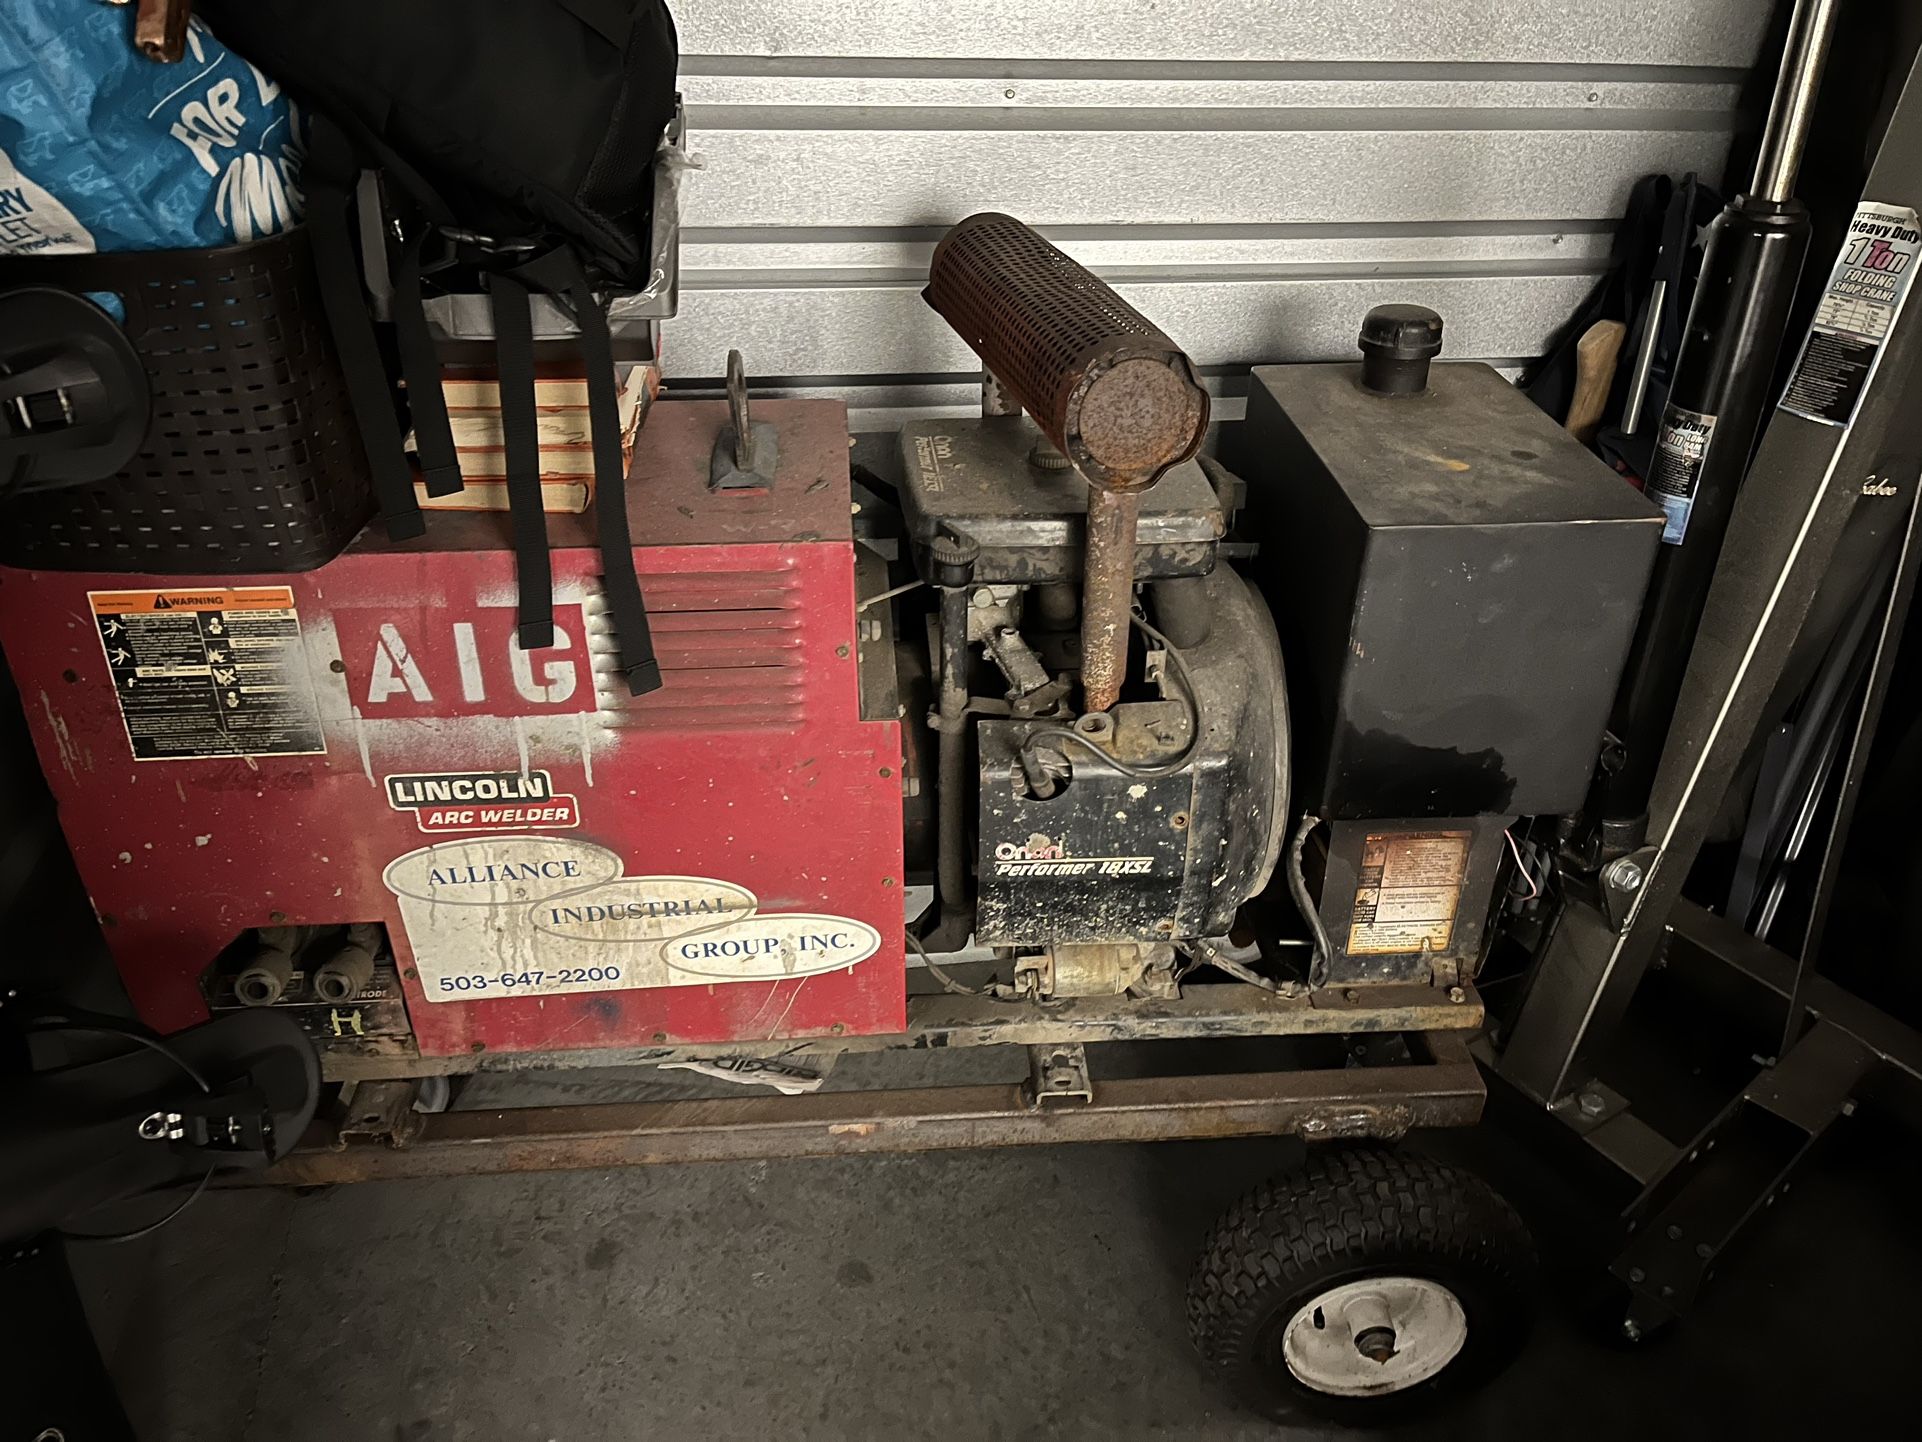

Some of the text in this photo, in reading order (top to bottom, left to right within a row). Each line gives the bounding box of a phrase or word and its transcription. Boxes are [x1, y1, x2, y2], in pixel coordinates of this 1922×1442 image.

[169, 78, 246, 178] FOR
[1850, 220, 1920, 244] Heavy Duty
[1844, 236, 1911, 275] 1 Ton
[1842, 267, 1898, 290] FOLDING
[1832, 280, 1862, 295] SHOP
[1860, 286, 1897, 303] CRANE
[169, 596, 224, 606] WARNING
[367, 622, 577, 704] AIG
[395, 777, 544, 803] LINCOLN
[427, 806, 570, 826] ARC WELDER
[426, 858, 583, 887] ALLIANCE
[996, 862, 1096, 877] Performer
[550, 897, 733, 925] INDUSTRIAL
[798, 932, 856, 953] INC.
[439, 965, 621, 992] 503-647-2200
